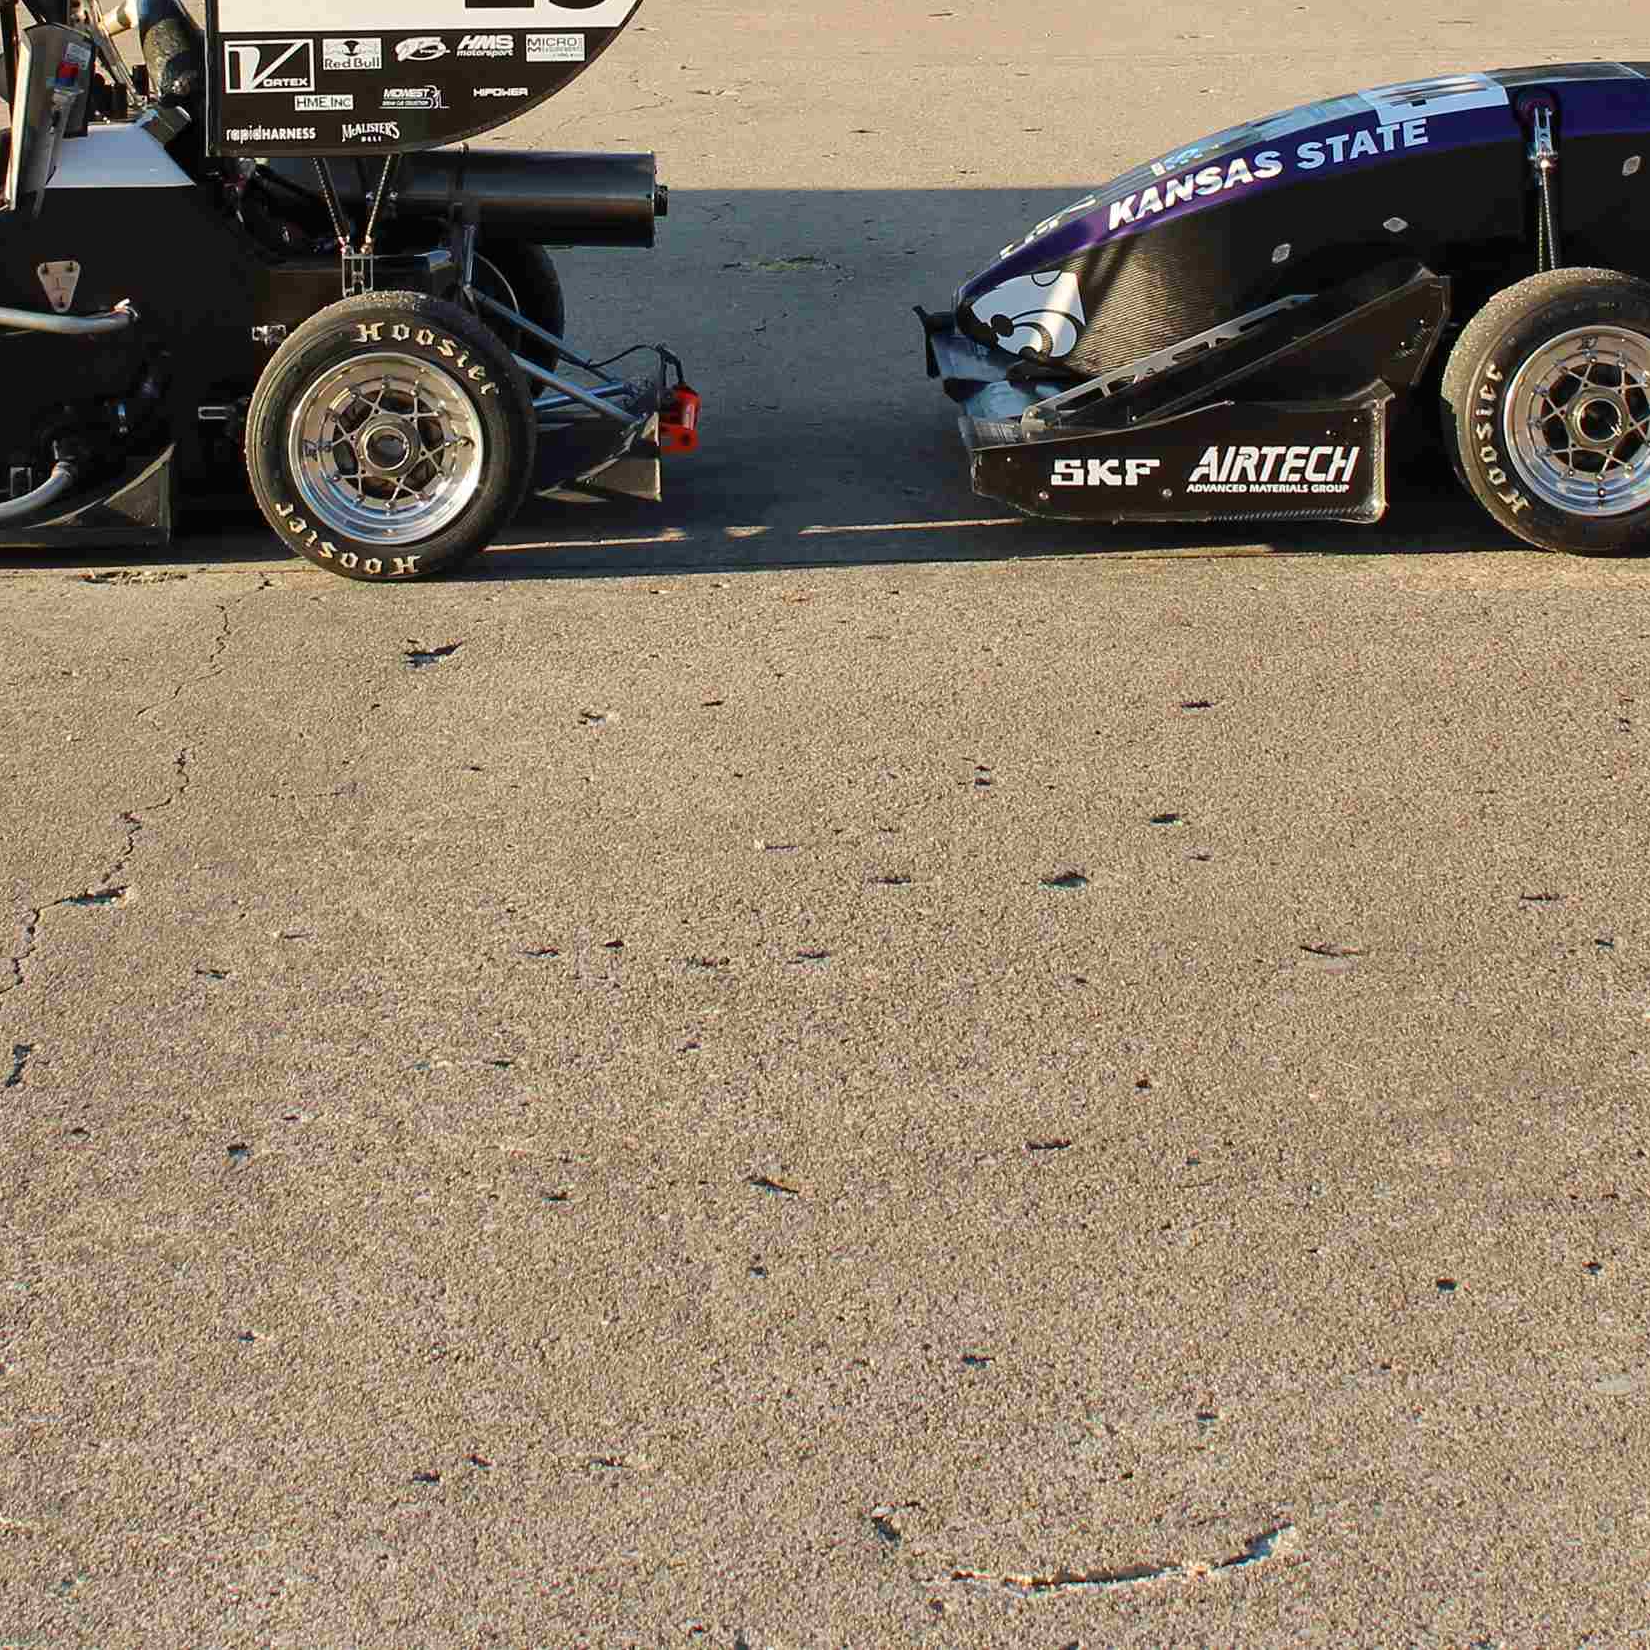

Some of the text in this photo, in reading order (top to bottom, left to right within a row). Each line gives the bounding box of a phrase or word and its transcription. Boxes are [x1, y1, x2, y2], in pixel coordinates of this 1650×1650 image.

[458, 34, 515, 50] HMS
[527, 37, 578, 48] MICRO
[456, 48, 514, 59] motorsport
[324, 56, 380, 69] Red Bull
[473, 87, 529, 98] HIPOWER
[1108, 118, 1429, 231] KANSAS STATE
[355, 321, 501, 397] Hoosier
[1188, 445, 1360, 482] AIRTECH
[1050, 458, 1160, 486] SKF
[1186, 482, 1350, 493] ADVANCED MATERIALS GROUP
